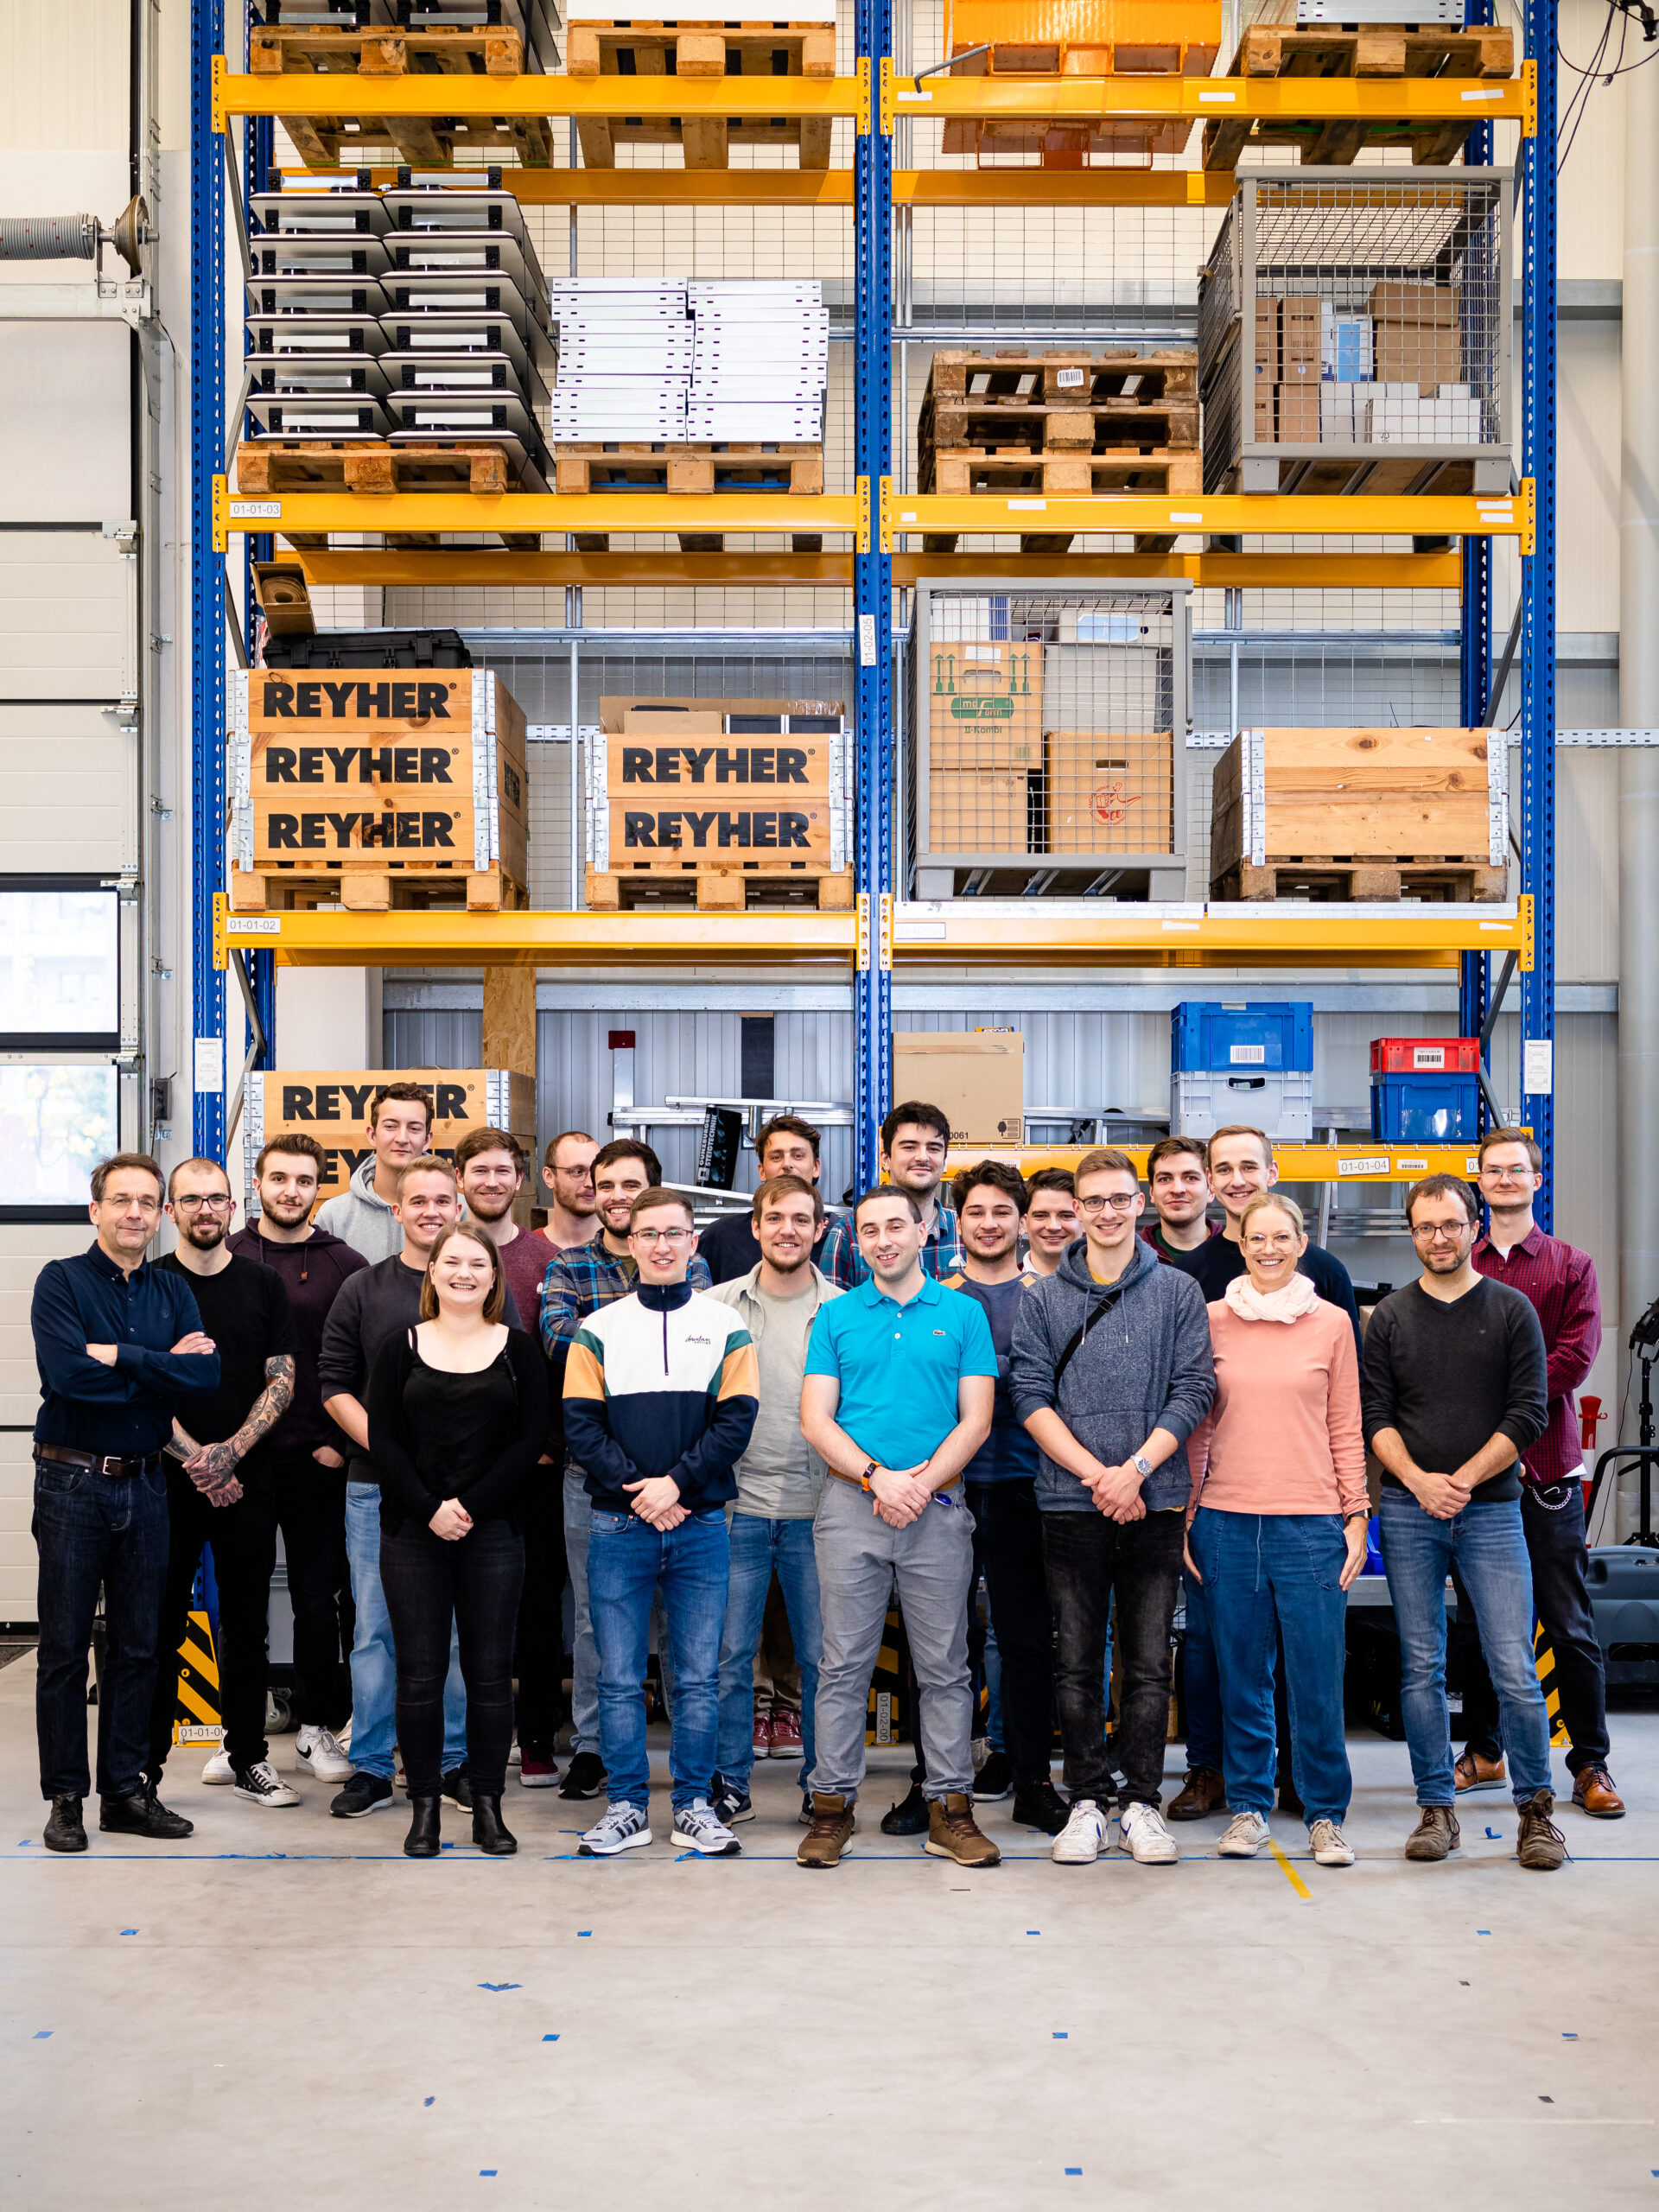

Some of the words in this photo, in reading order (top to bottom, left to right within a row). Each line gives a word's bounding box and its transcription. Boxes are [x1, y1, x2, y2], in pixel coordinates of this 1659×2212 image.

[233, 505, 279, 514] 01-01-03
[863, 618, 874, 664] 01-02-05
[230, 920, 276, 930] 01-01-02
[1341, 1160, 1387, 1172] 01-01-04
[879, 1695, 889, 1742] 01-02-00
